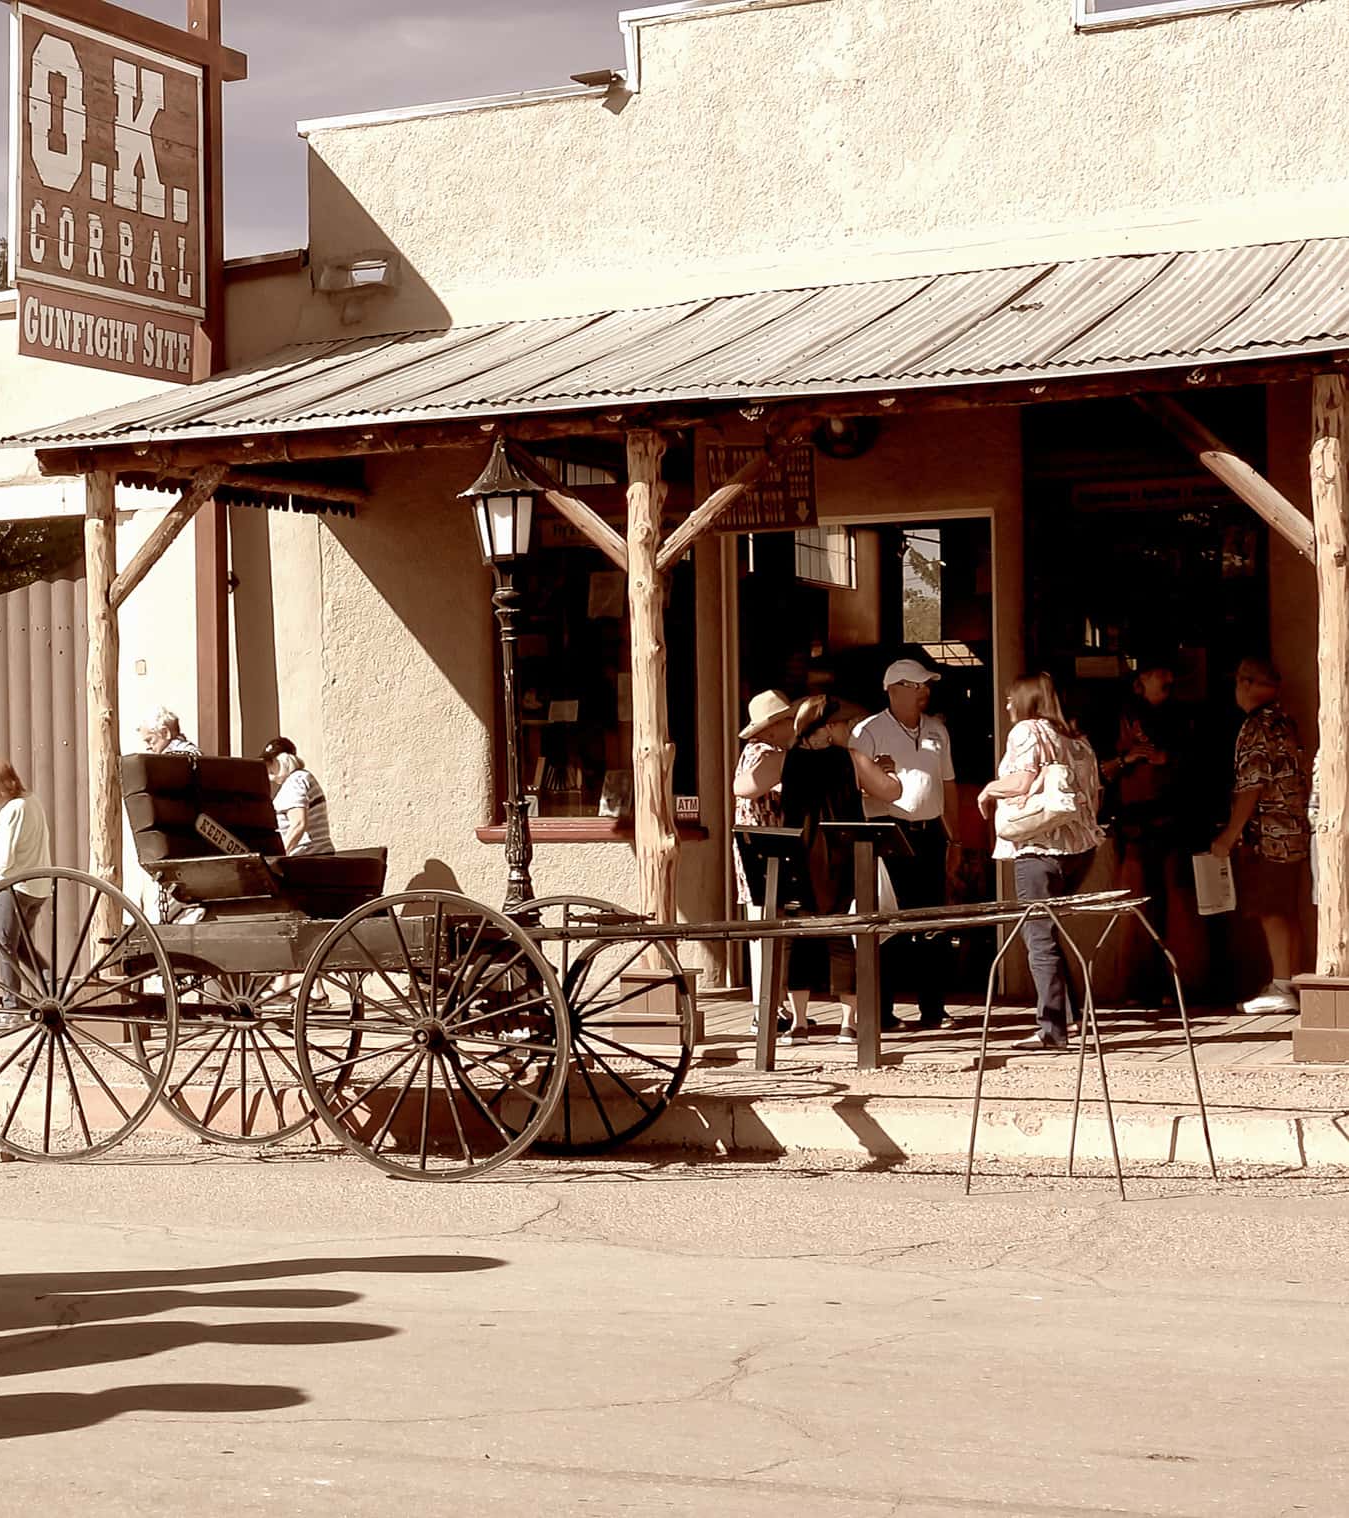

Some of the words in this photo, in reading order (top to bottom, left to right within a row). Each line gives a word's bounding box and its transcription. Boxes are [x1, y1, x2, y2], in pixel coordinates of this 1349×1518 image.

[29, 33, 188, 223] O.K.
[29, 200, 192, 298] CORRAL
[23, 296, 137, 365] GUNFIGHT
[143, 321, 191, 374] SITE
[200, 819, 227, 844] KEEP
[678, 799, 697, 810] ATM
